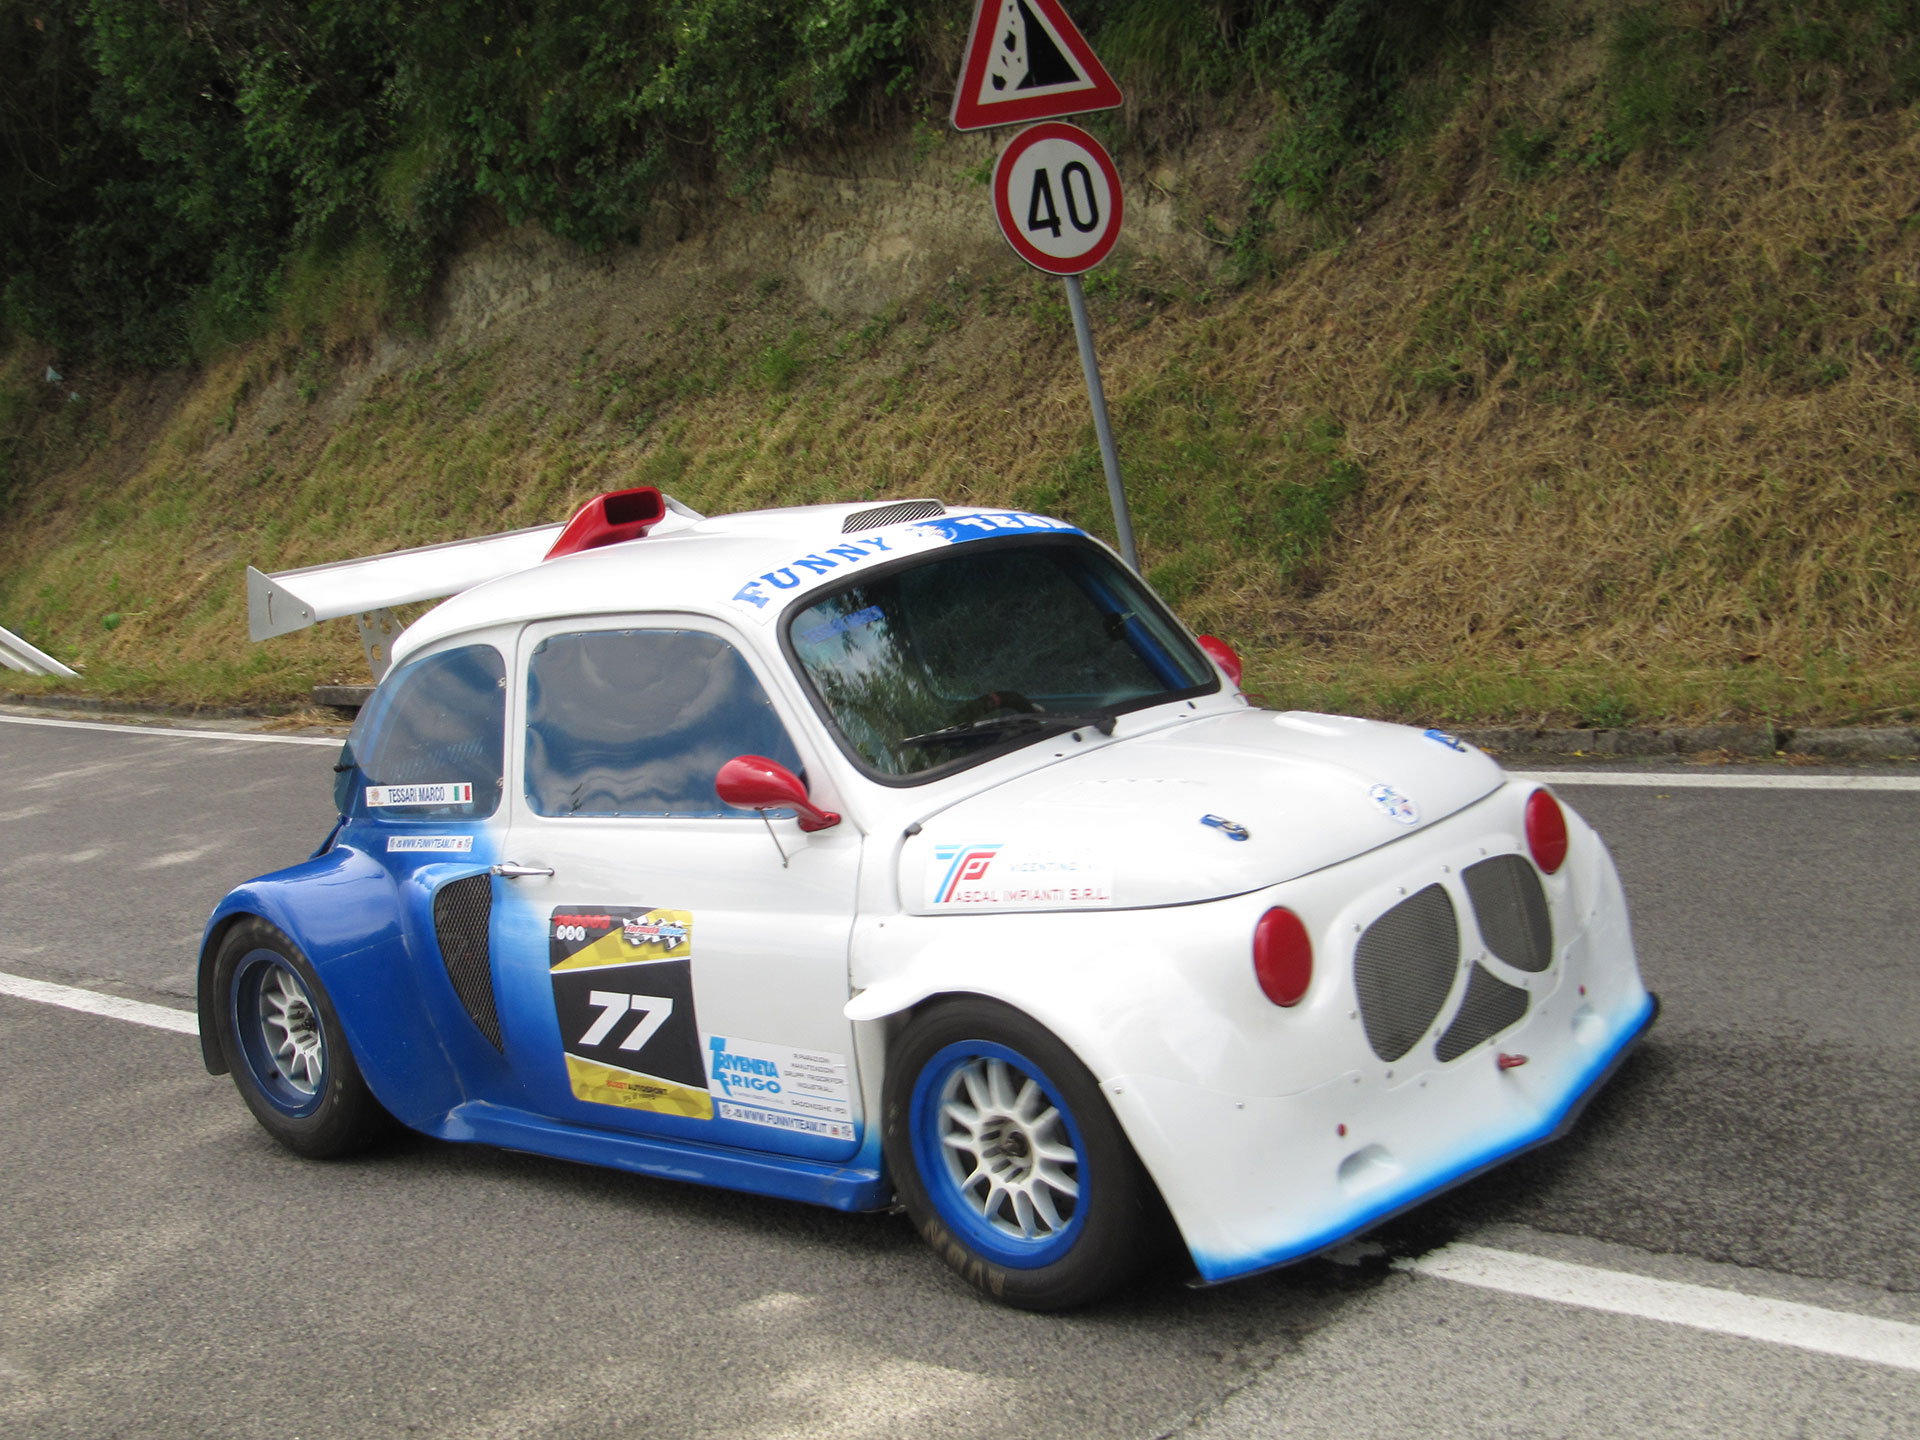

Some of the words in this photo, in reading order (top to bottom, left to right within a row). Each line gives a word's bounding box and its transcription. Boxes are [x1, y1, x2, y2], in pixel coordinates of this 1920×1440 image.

[1028, 161, 1099, 238] 40
[731, 537, 893, 609] FUNNY
[388, 787, 417, 803] TESSARI
[418, 786, 445, 802] MARCO
[1003, 889, 1064, 902] IMPIANTI
[578, 990, 674, 1051] 77
[743, 1109, 828, 1133] WWW.FUNNYTEAM.IT
